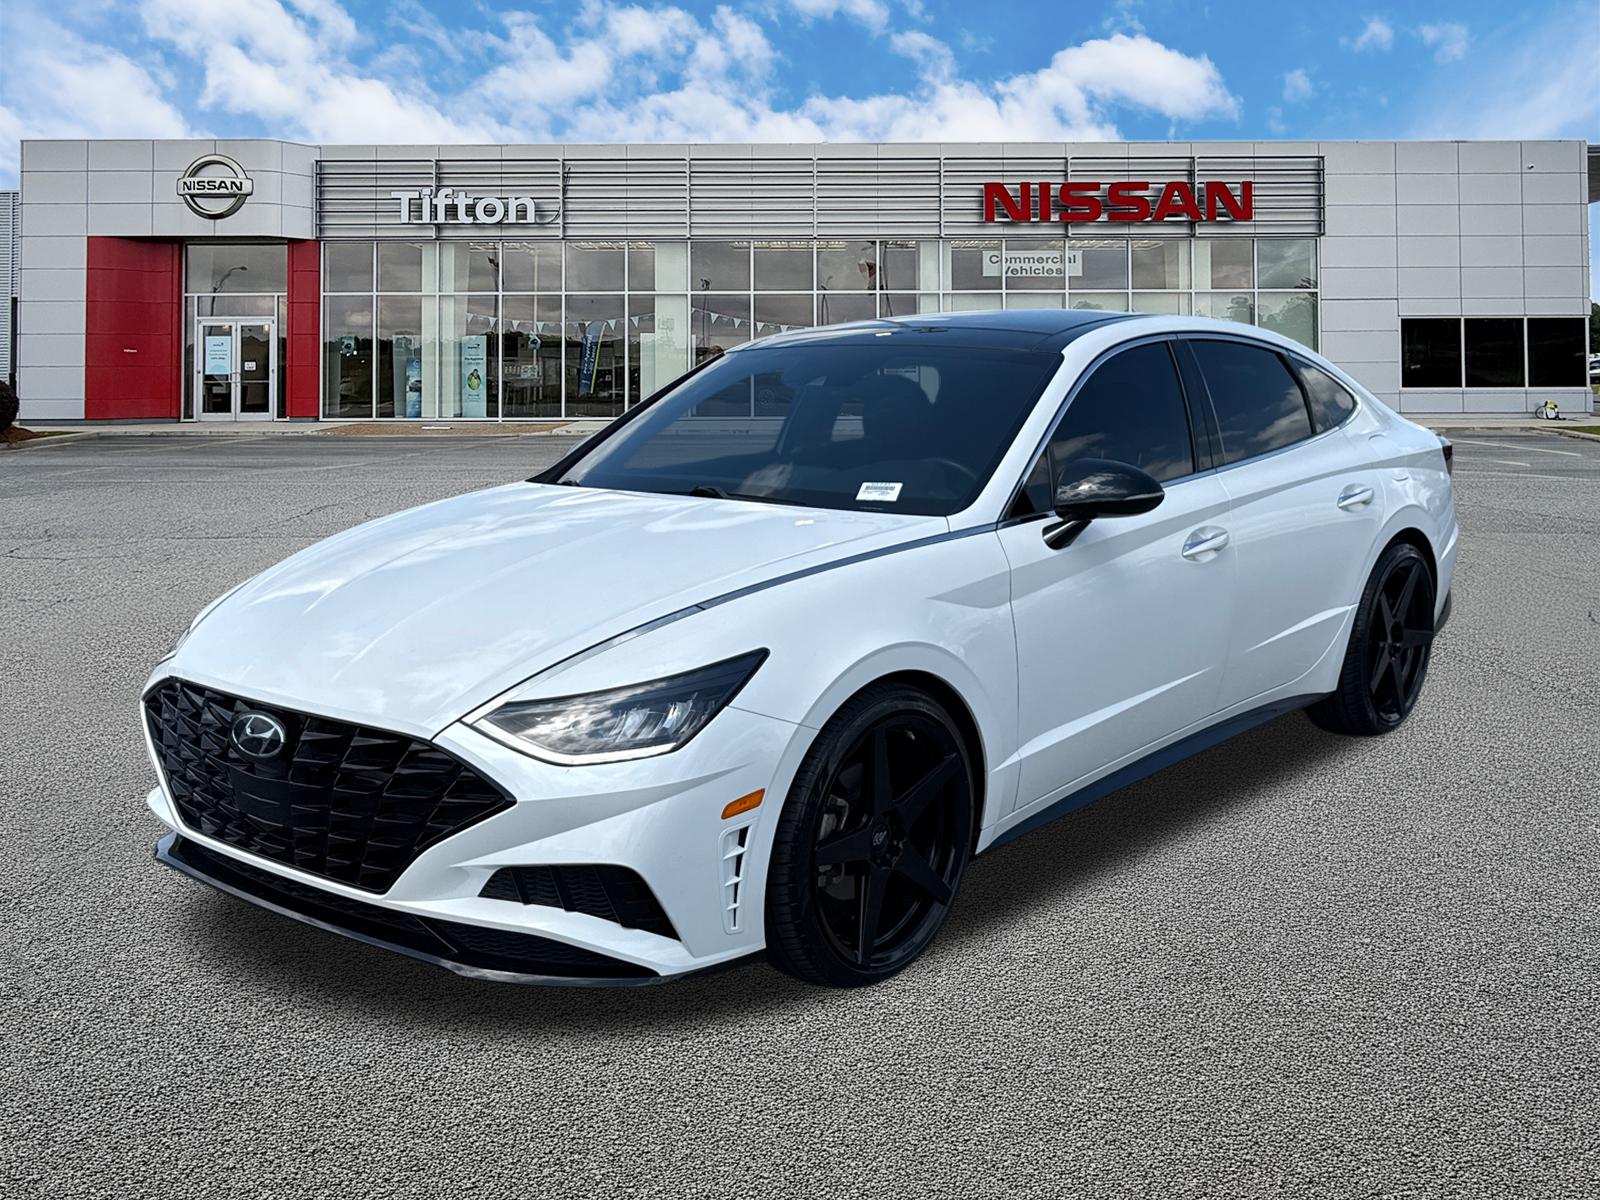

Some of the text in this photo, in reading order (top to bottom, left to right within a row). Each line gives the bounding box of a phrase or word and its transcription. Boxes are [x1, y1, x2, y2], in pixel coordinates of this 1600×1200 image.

[183, 181, 243, 191] NISSAN
[984, 181, 1253, 222] NISSAN
[391, 188, 536, 224] Tifton
